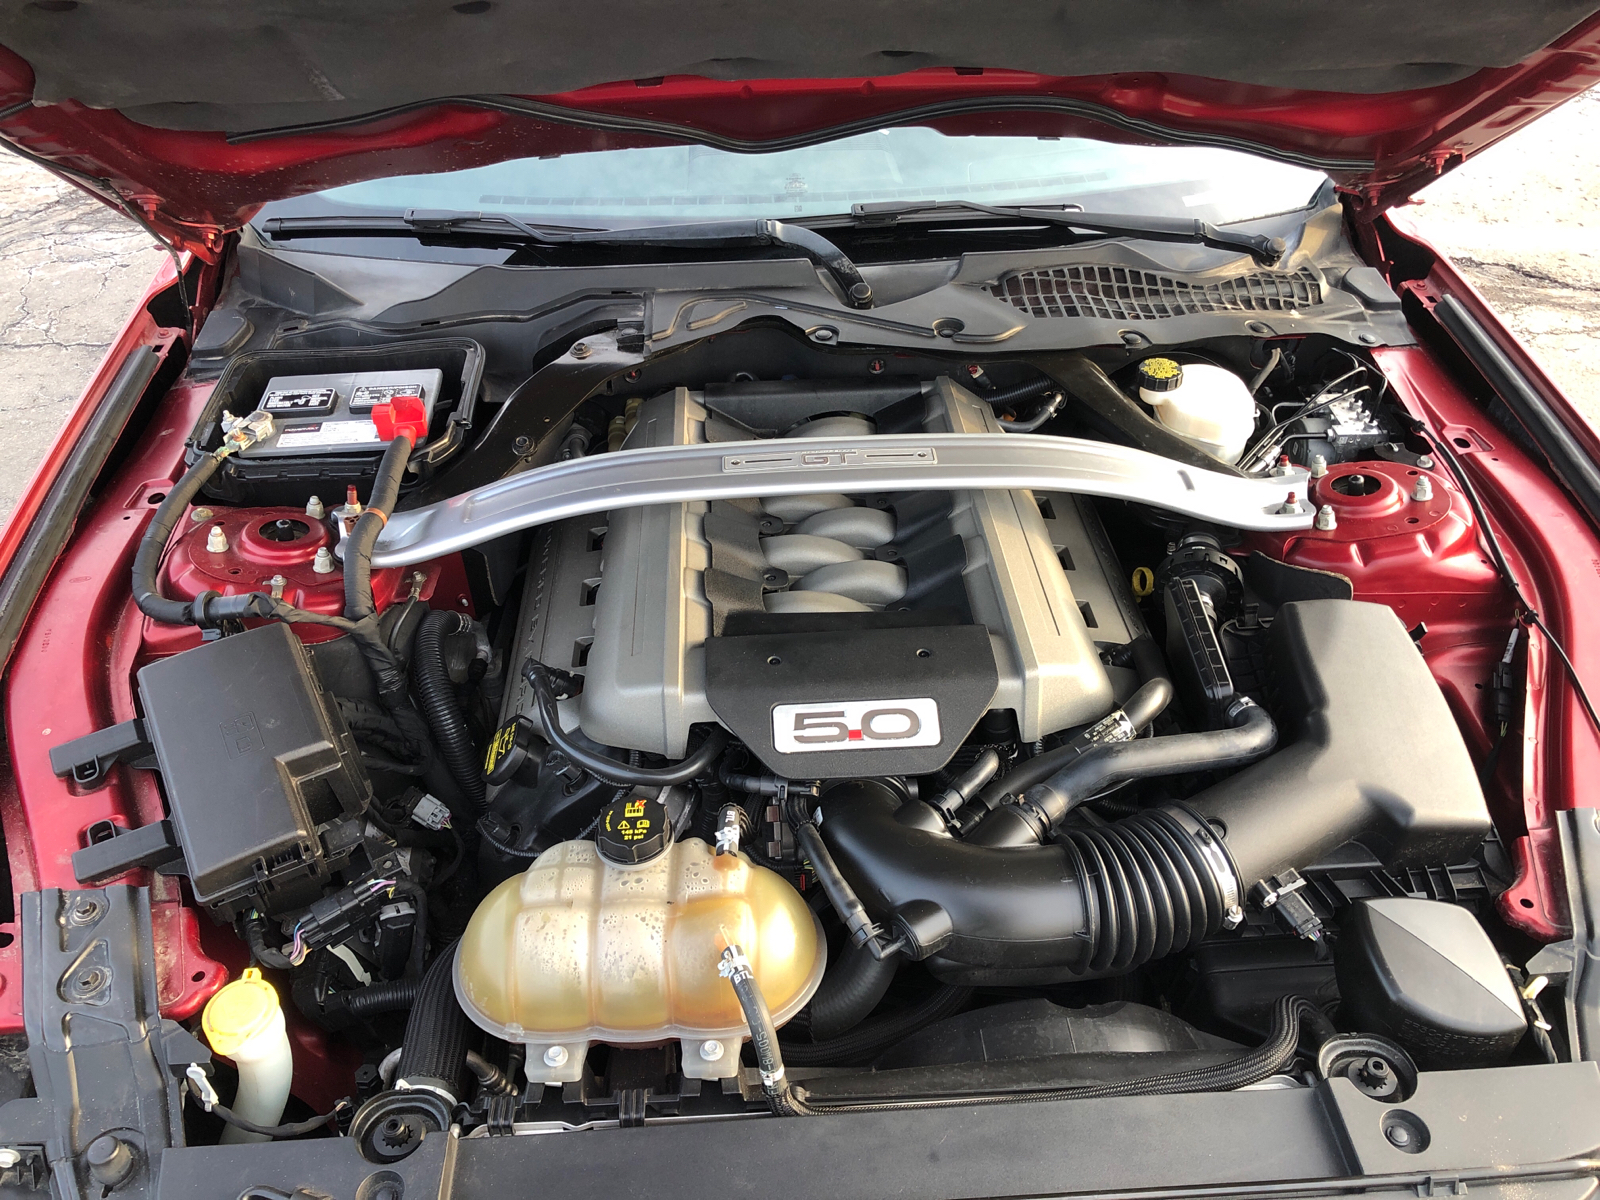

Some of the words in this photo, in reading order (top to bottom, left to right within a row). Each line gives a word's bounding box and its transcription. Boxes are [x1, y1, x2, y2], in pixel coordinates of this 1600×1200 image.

[801, 450, 858, 466] GT
[793, 708, 922, 744] 5.0
[733, 970, 754, 985] BTL
